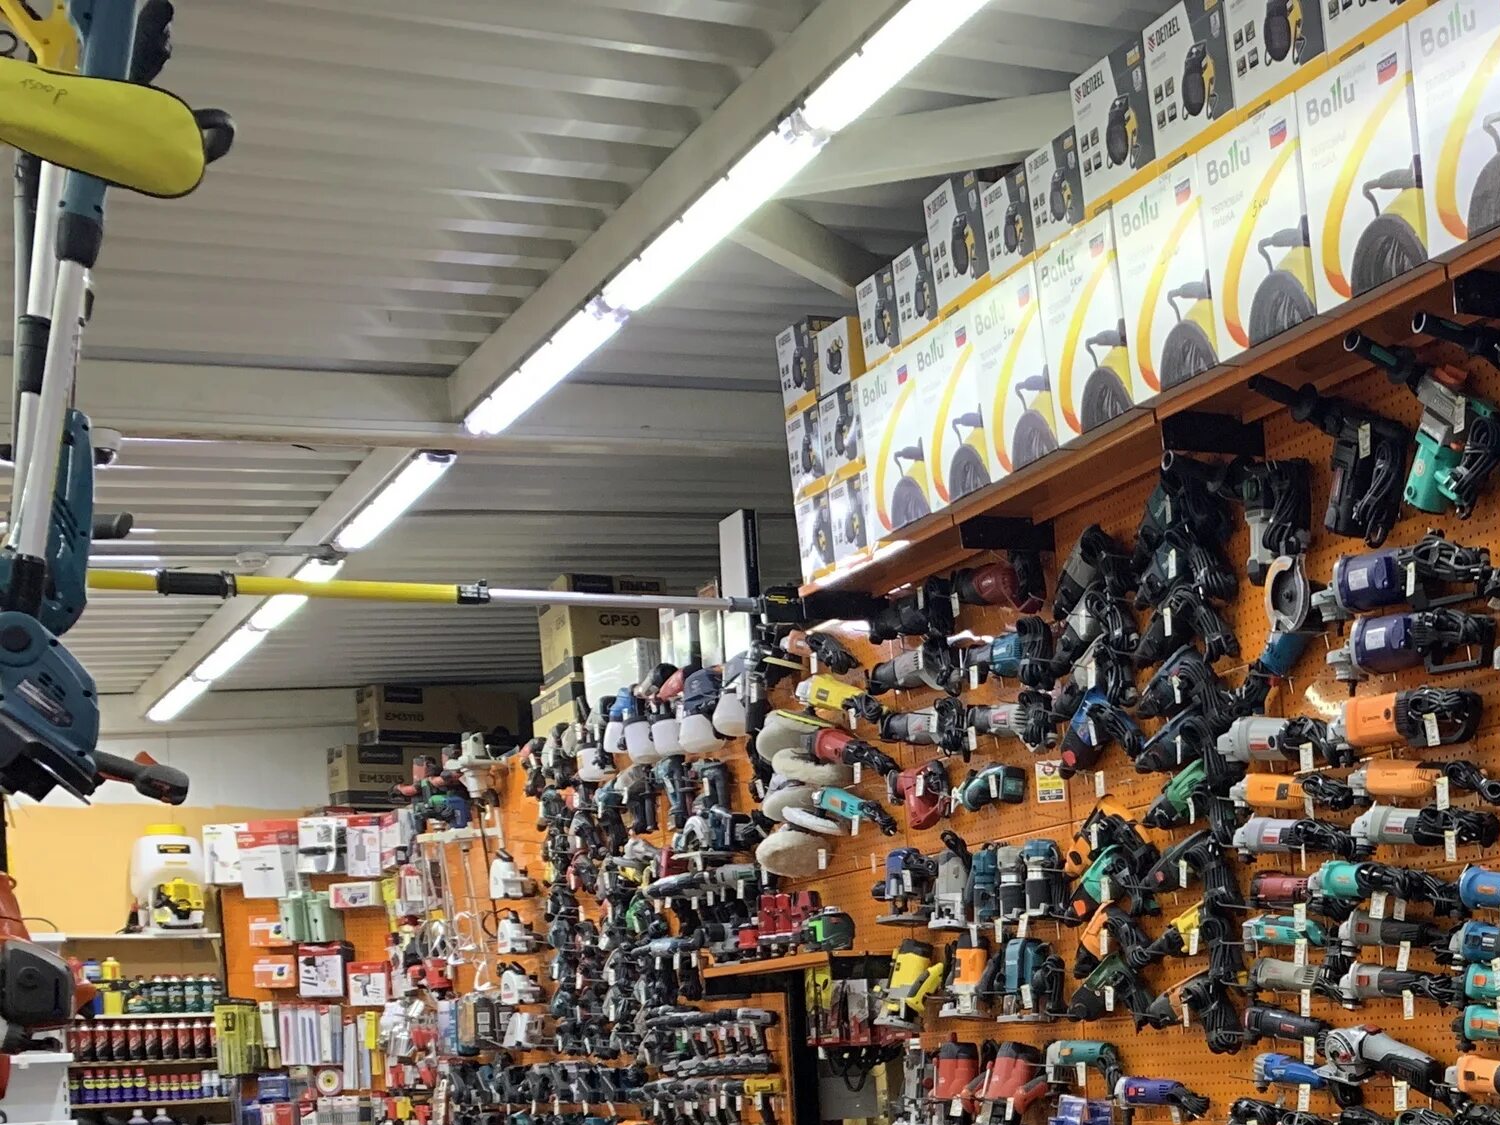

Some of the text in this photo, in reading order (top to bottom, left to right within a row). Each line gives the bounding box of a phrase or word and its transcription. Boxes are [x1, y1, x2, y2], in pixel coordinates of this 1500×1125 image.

[1420, 3, 1477, 56] Ballu
[1306, 76, 1356, 127] Ballu
[1206, 137, 1251, 187] Ballu
[1120, 197, 1160, 239] Ballu
[600, 614, 642, 628] GP50
